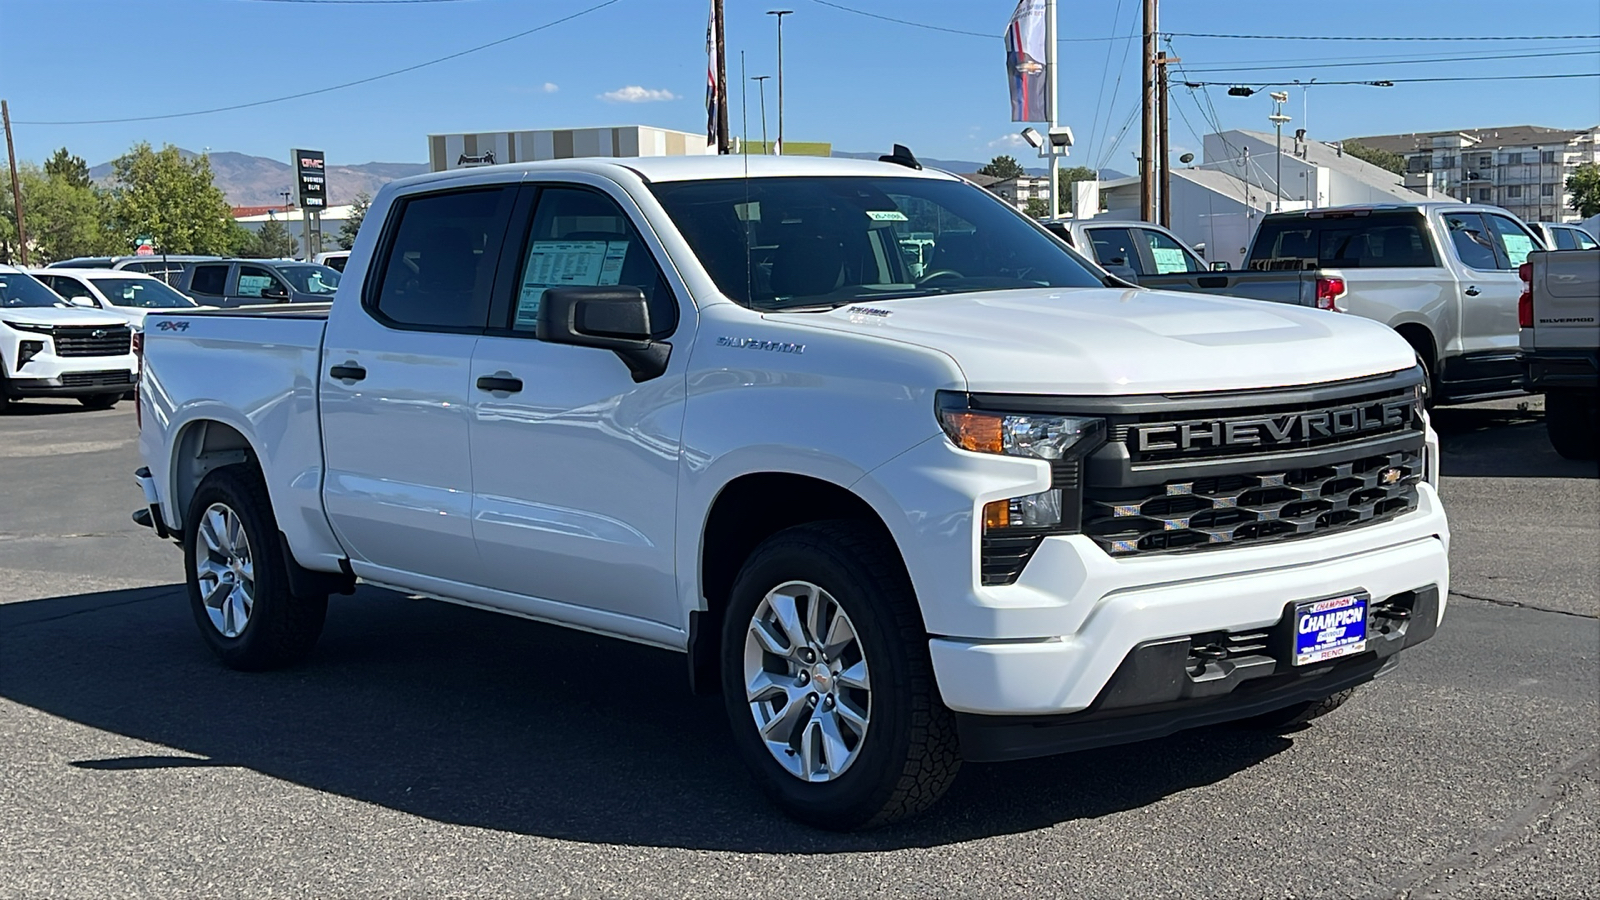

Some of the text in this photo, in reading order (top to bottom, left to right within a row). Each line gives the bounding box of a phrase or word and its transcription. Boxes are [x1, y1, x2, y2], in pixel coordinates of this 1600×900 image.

[301, 158, 323, 168] GMC
[716, 336, 806, 355] SILVERADO
[1139, 400, 1418, 451] CHEVROLET
[1316, 597, 1351, 611] CHAMPION
[1298, 607, 1364, 635] CHAMPION
[1321, 648, 1344, 659] RENO
